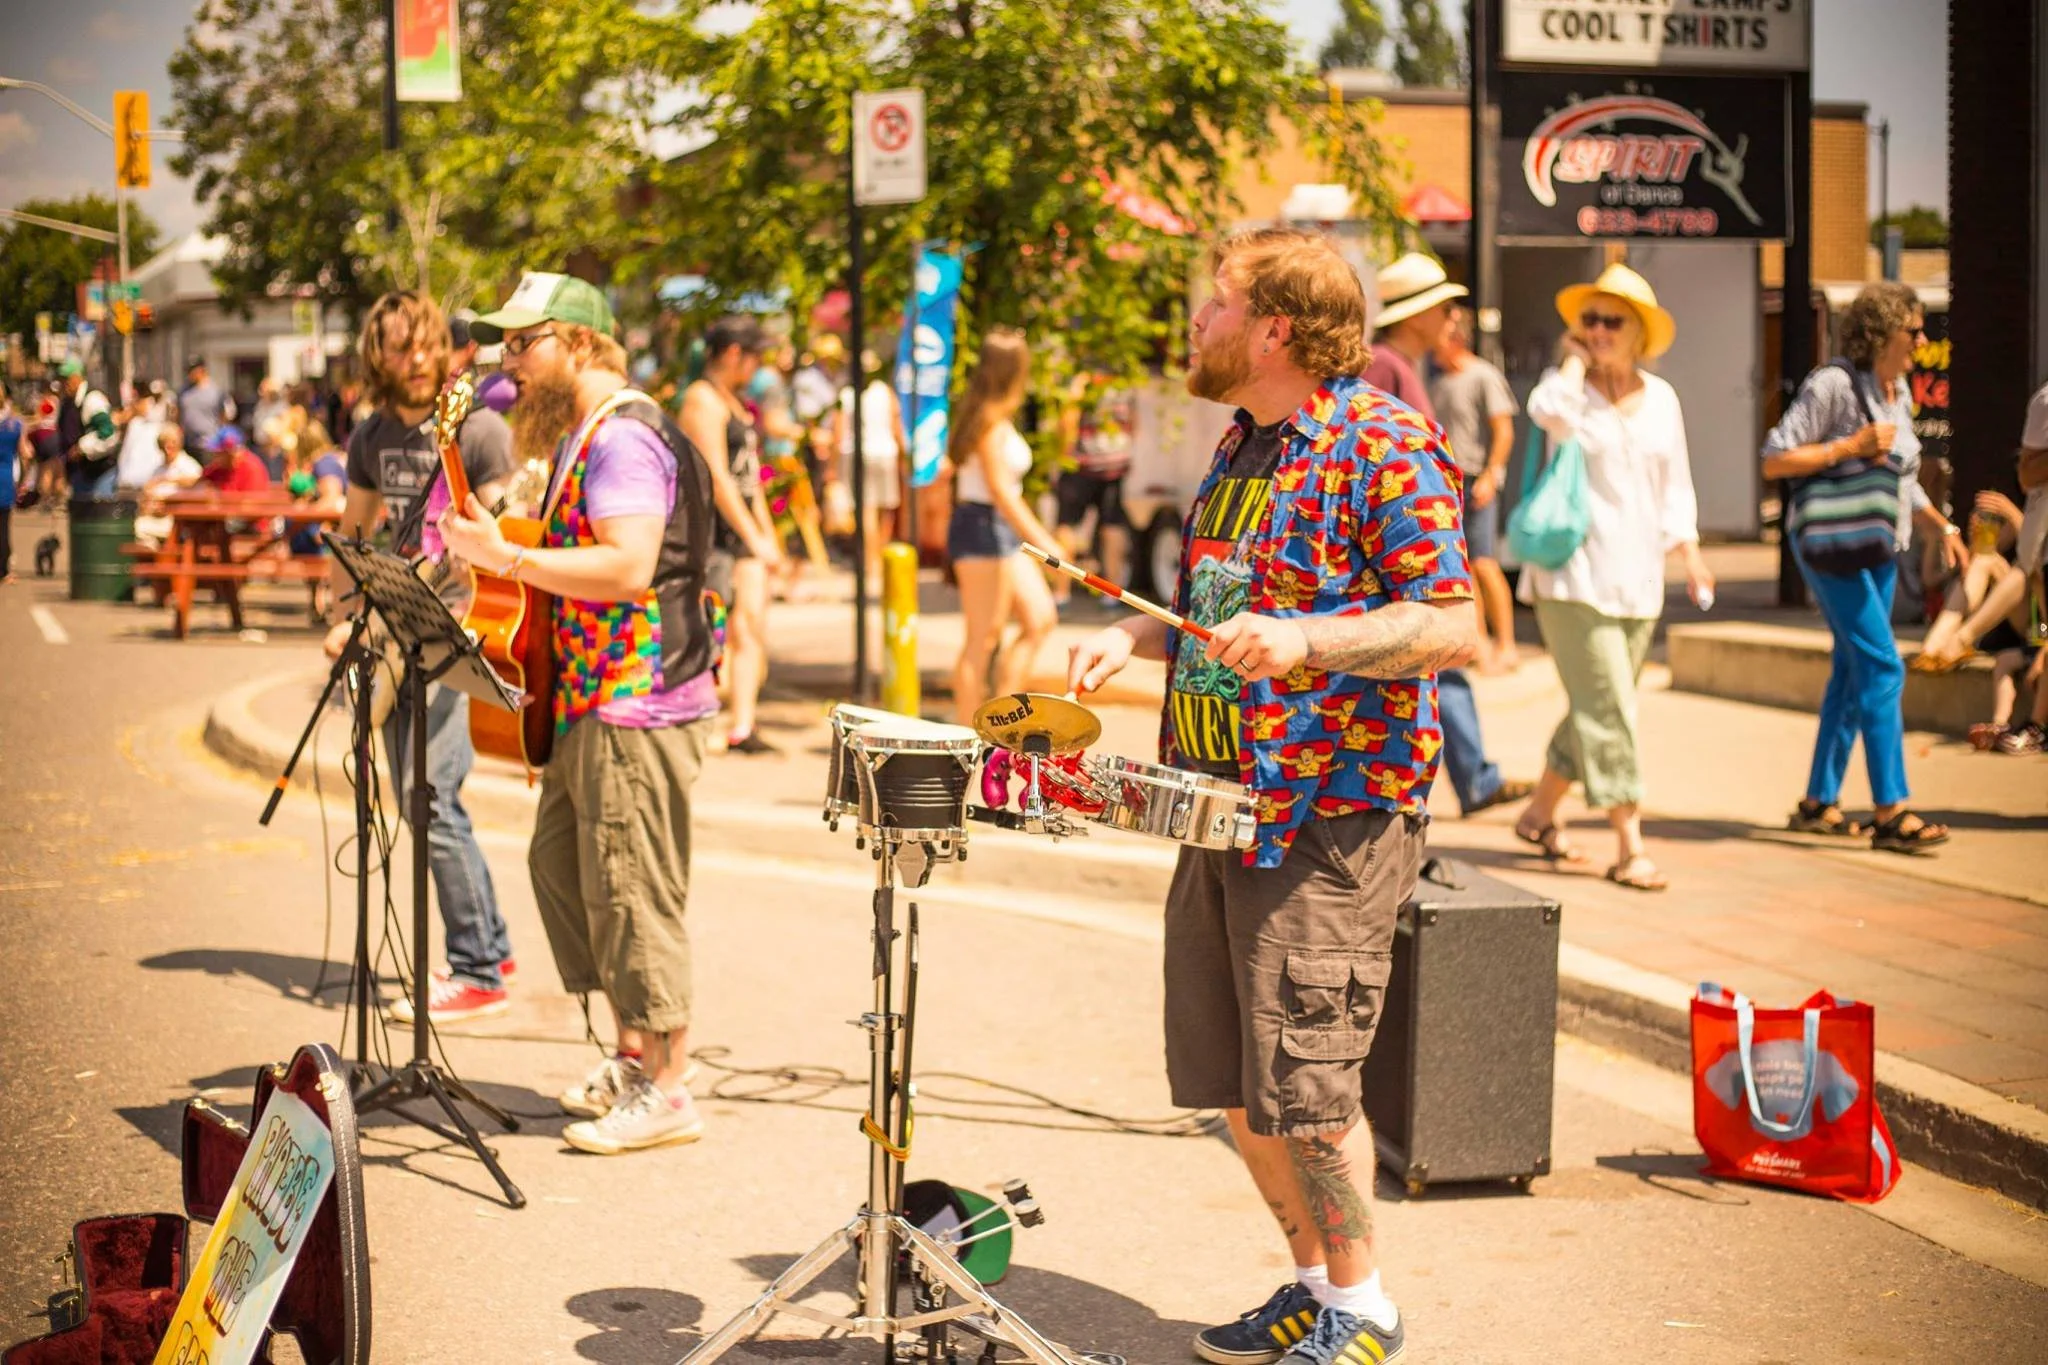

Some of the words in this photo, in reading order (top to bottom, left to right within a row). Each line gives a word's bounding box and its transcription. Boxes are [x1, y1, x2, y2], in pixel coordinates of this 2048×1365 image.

[1540, 9, 1622, 42] COOL
[1553, 133, 1706, 183] SPIRIT
[1623, 183, 1684, 205] Dance
[203, 1236, 258, 1337] THE
